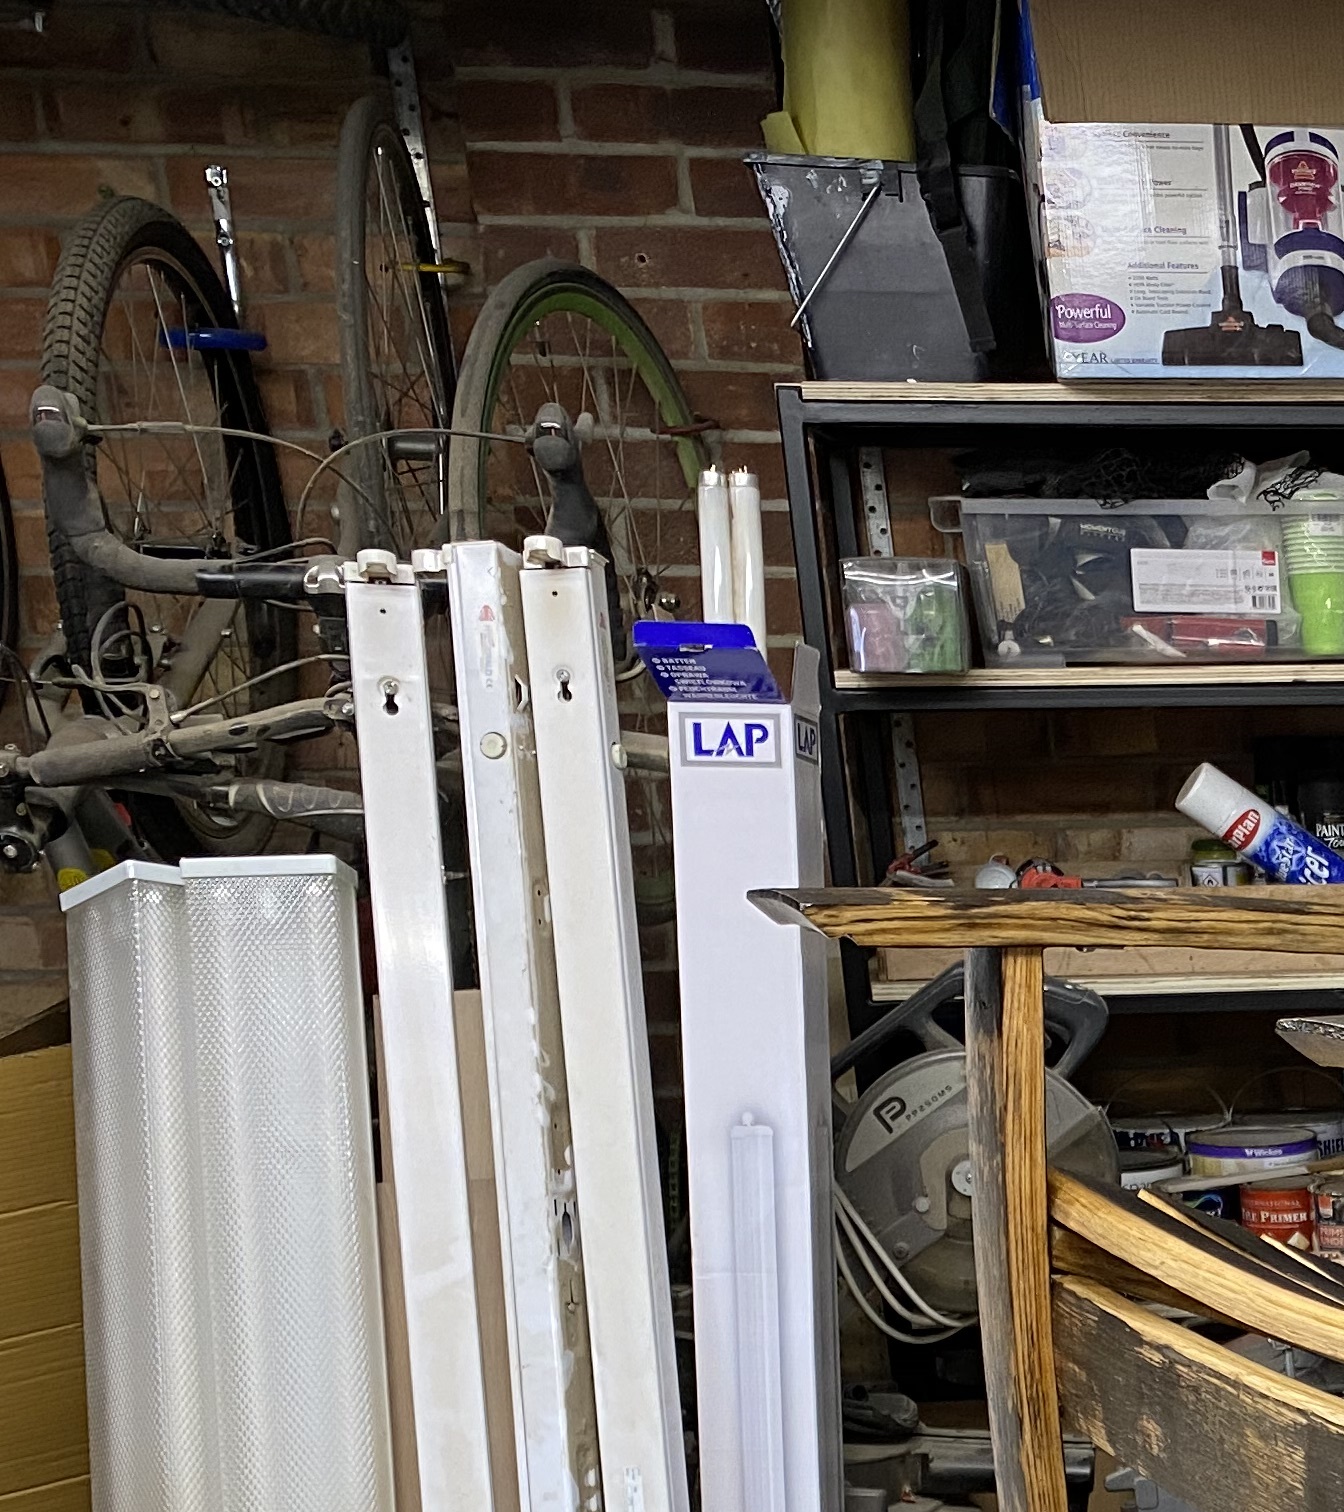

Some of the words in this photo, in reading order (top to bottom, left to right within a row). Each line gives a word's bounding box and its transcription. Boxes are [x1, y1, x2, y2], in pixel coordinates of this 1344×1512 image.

[1167, 262, 1199, 270] Features
[1056, 304, 1112, 319] Powerful
[1072, 352, 1109, 364] YEAR
[693, 720, 769, 757] LAP
[797, 722, 816, 755] LAP
[1260, 1210, 1308, 1223] PRIMER
